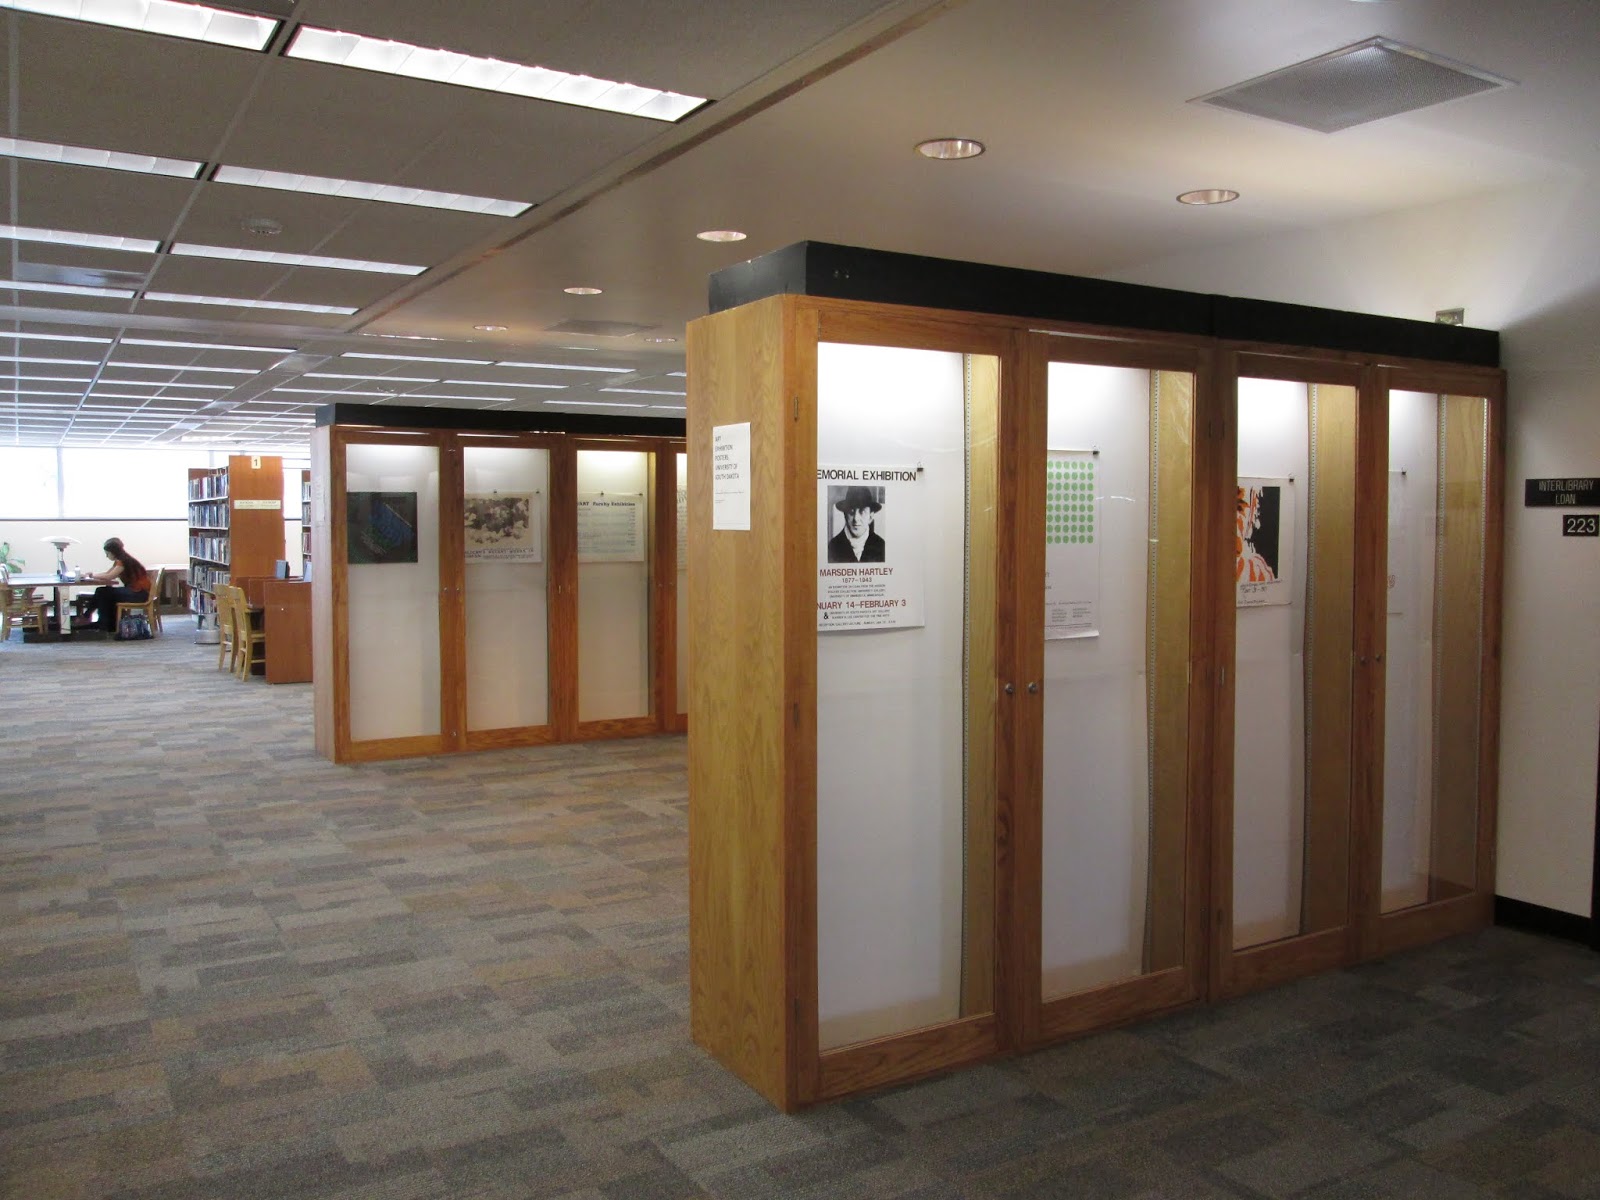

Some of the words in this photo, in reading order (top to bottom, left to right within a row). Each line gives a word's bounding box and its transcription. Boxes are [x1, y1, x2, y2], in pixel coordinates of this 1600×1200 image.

[254, 458, 258, 467] 1
[862, 470, 917, 481] EXHIBITION
[1538, 479, 1594, 492] INTERLIBRARY
[1555, 493, 1576, 505] LOAN
[1567, 518, 1596, 533] 223
[819, 568, 857, 577] MARSDEN
[859, 567, 893, 576] HARTLEY
[901, 599, 907, 607] 3
